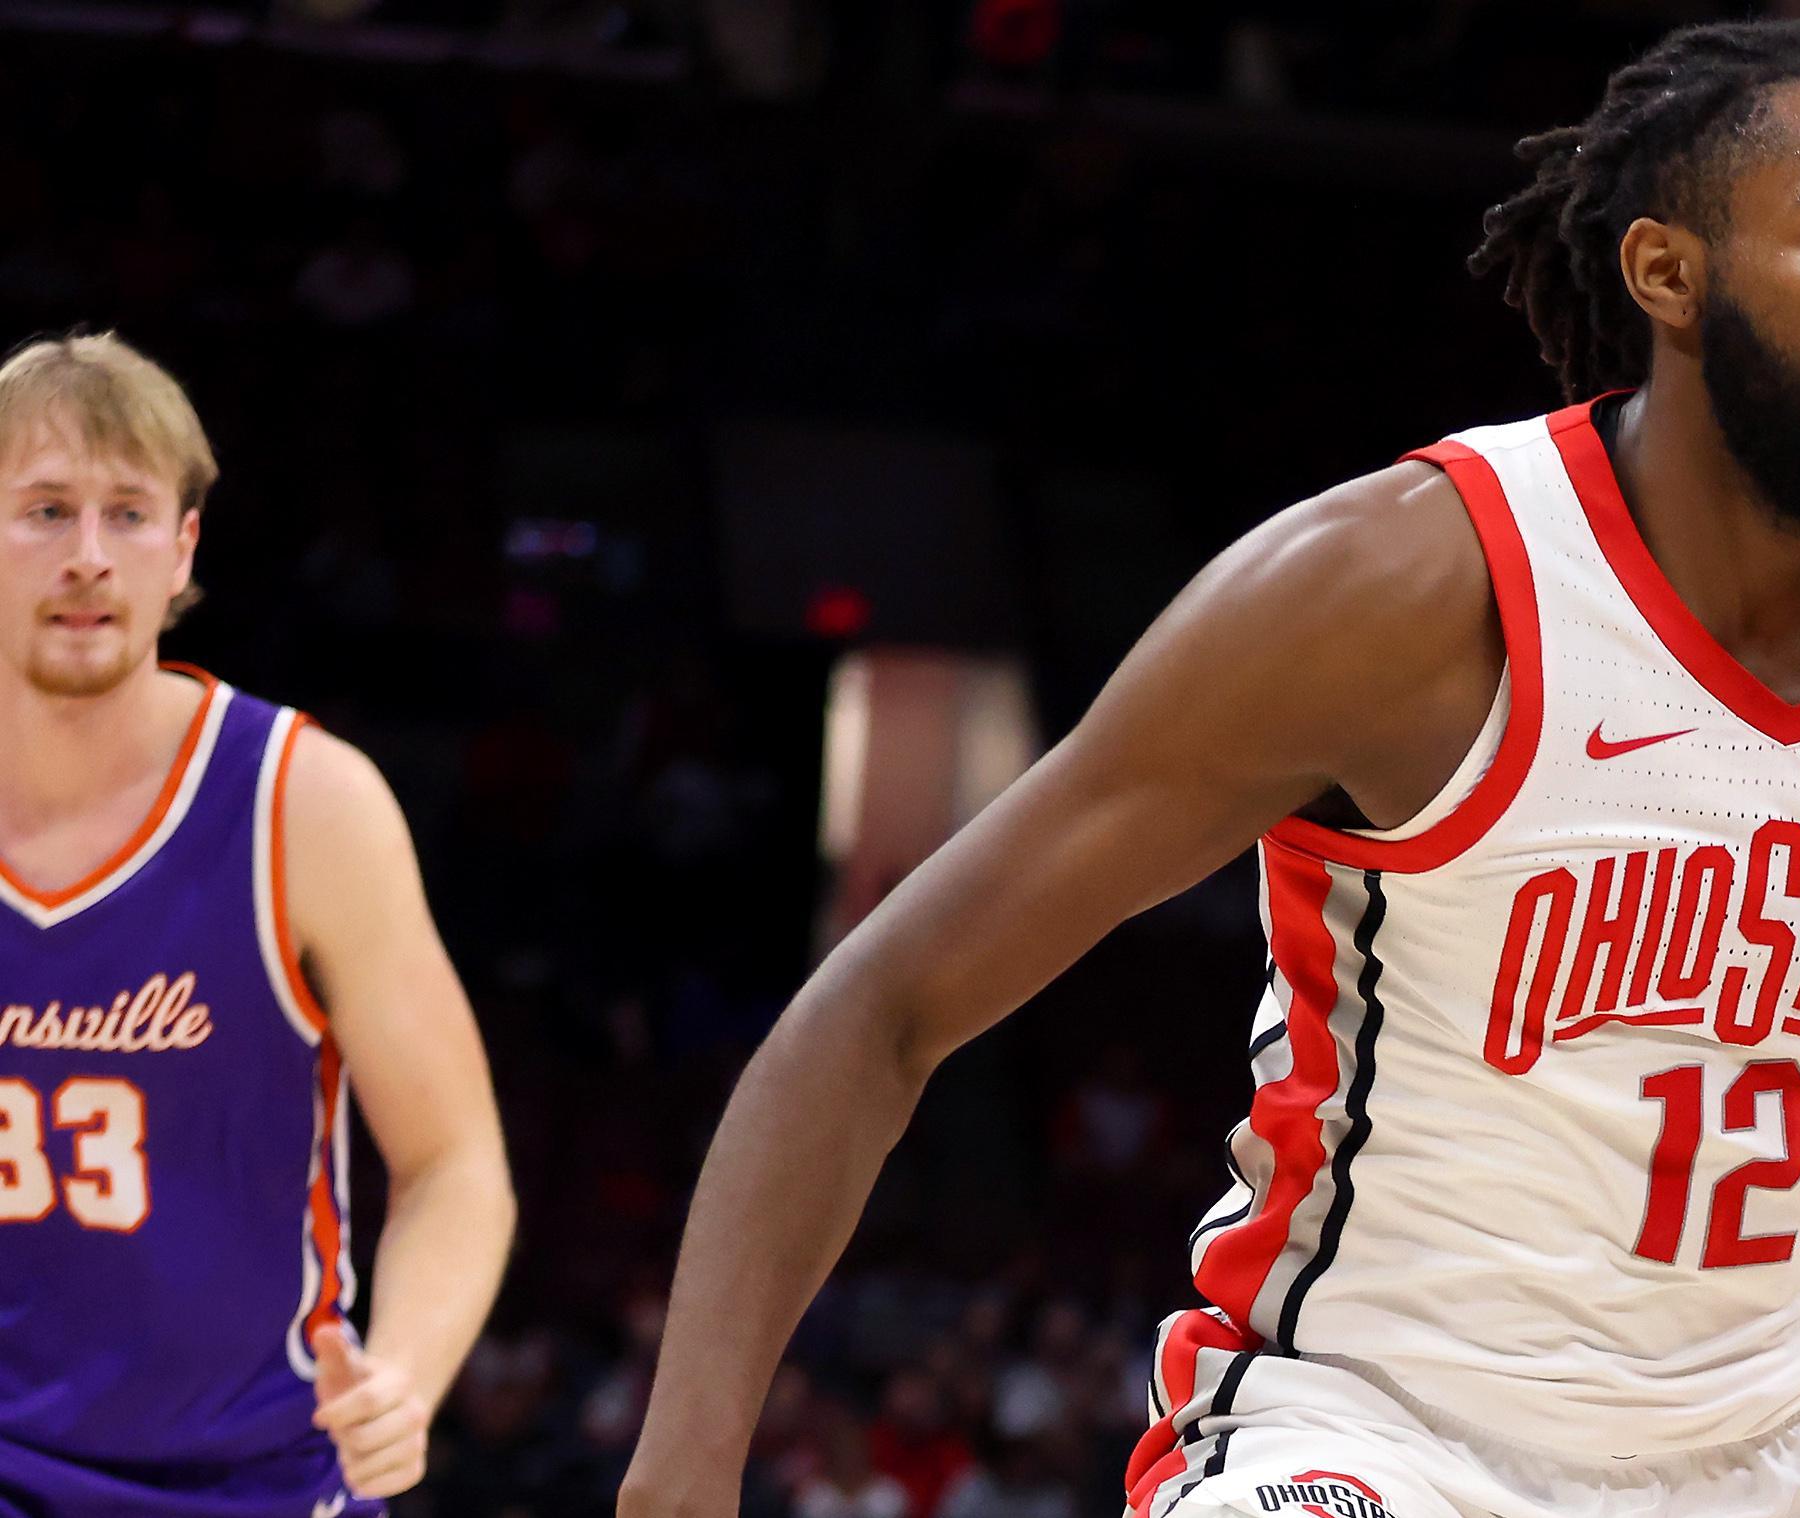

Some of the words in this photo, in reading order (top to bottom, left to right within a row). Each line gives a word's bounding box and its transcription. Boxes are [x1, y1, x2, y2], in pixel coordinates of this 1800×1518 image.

[1483, 845, 1735, 1076] OHIO
[0, 971, 214, 1053] nsville
[1256, 1484, 1329, 1512] OHIO
